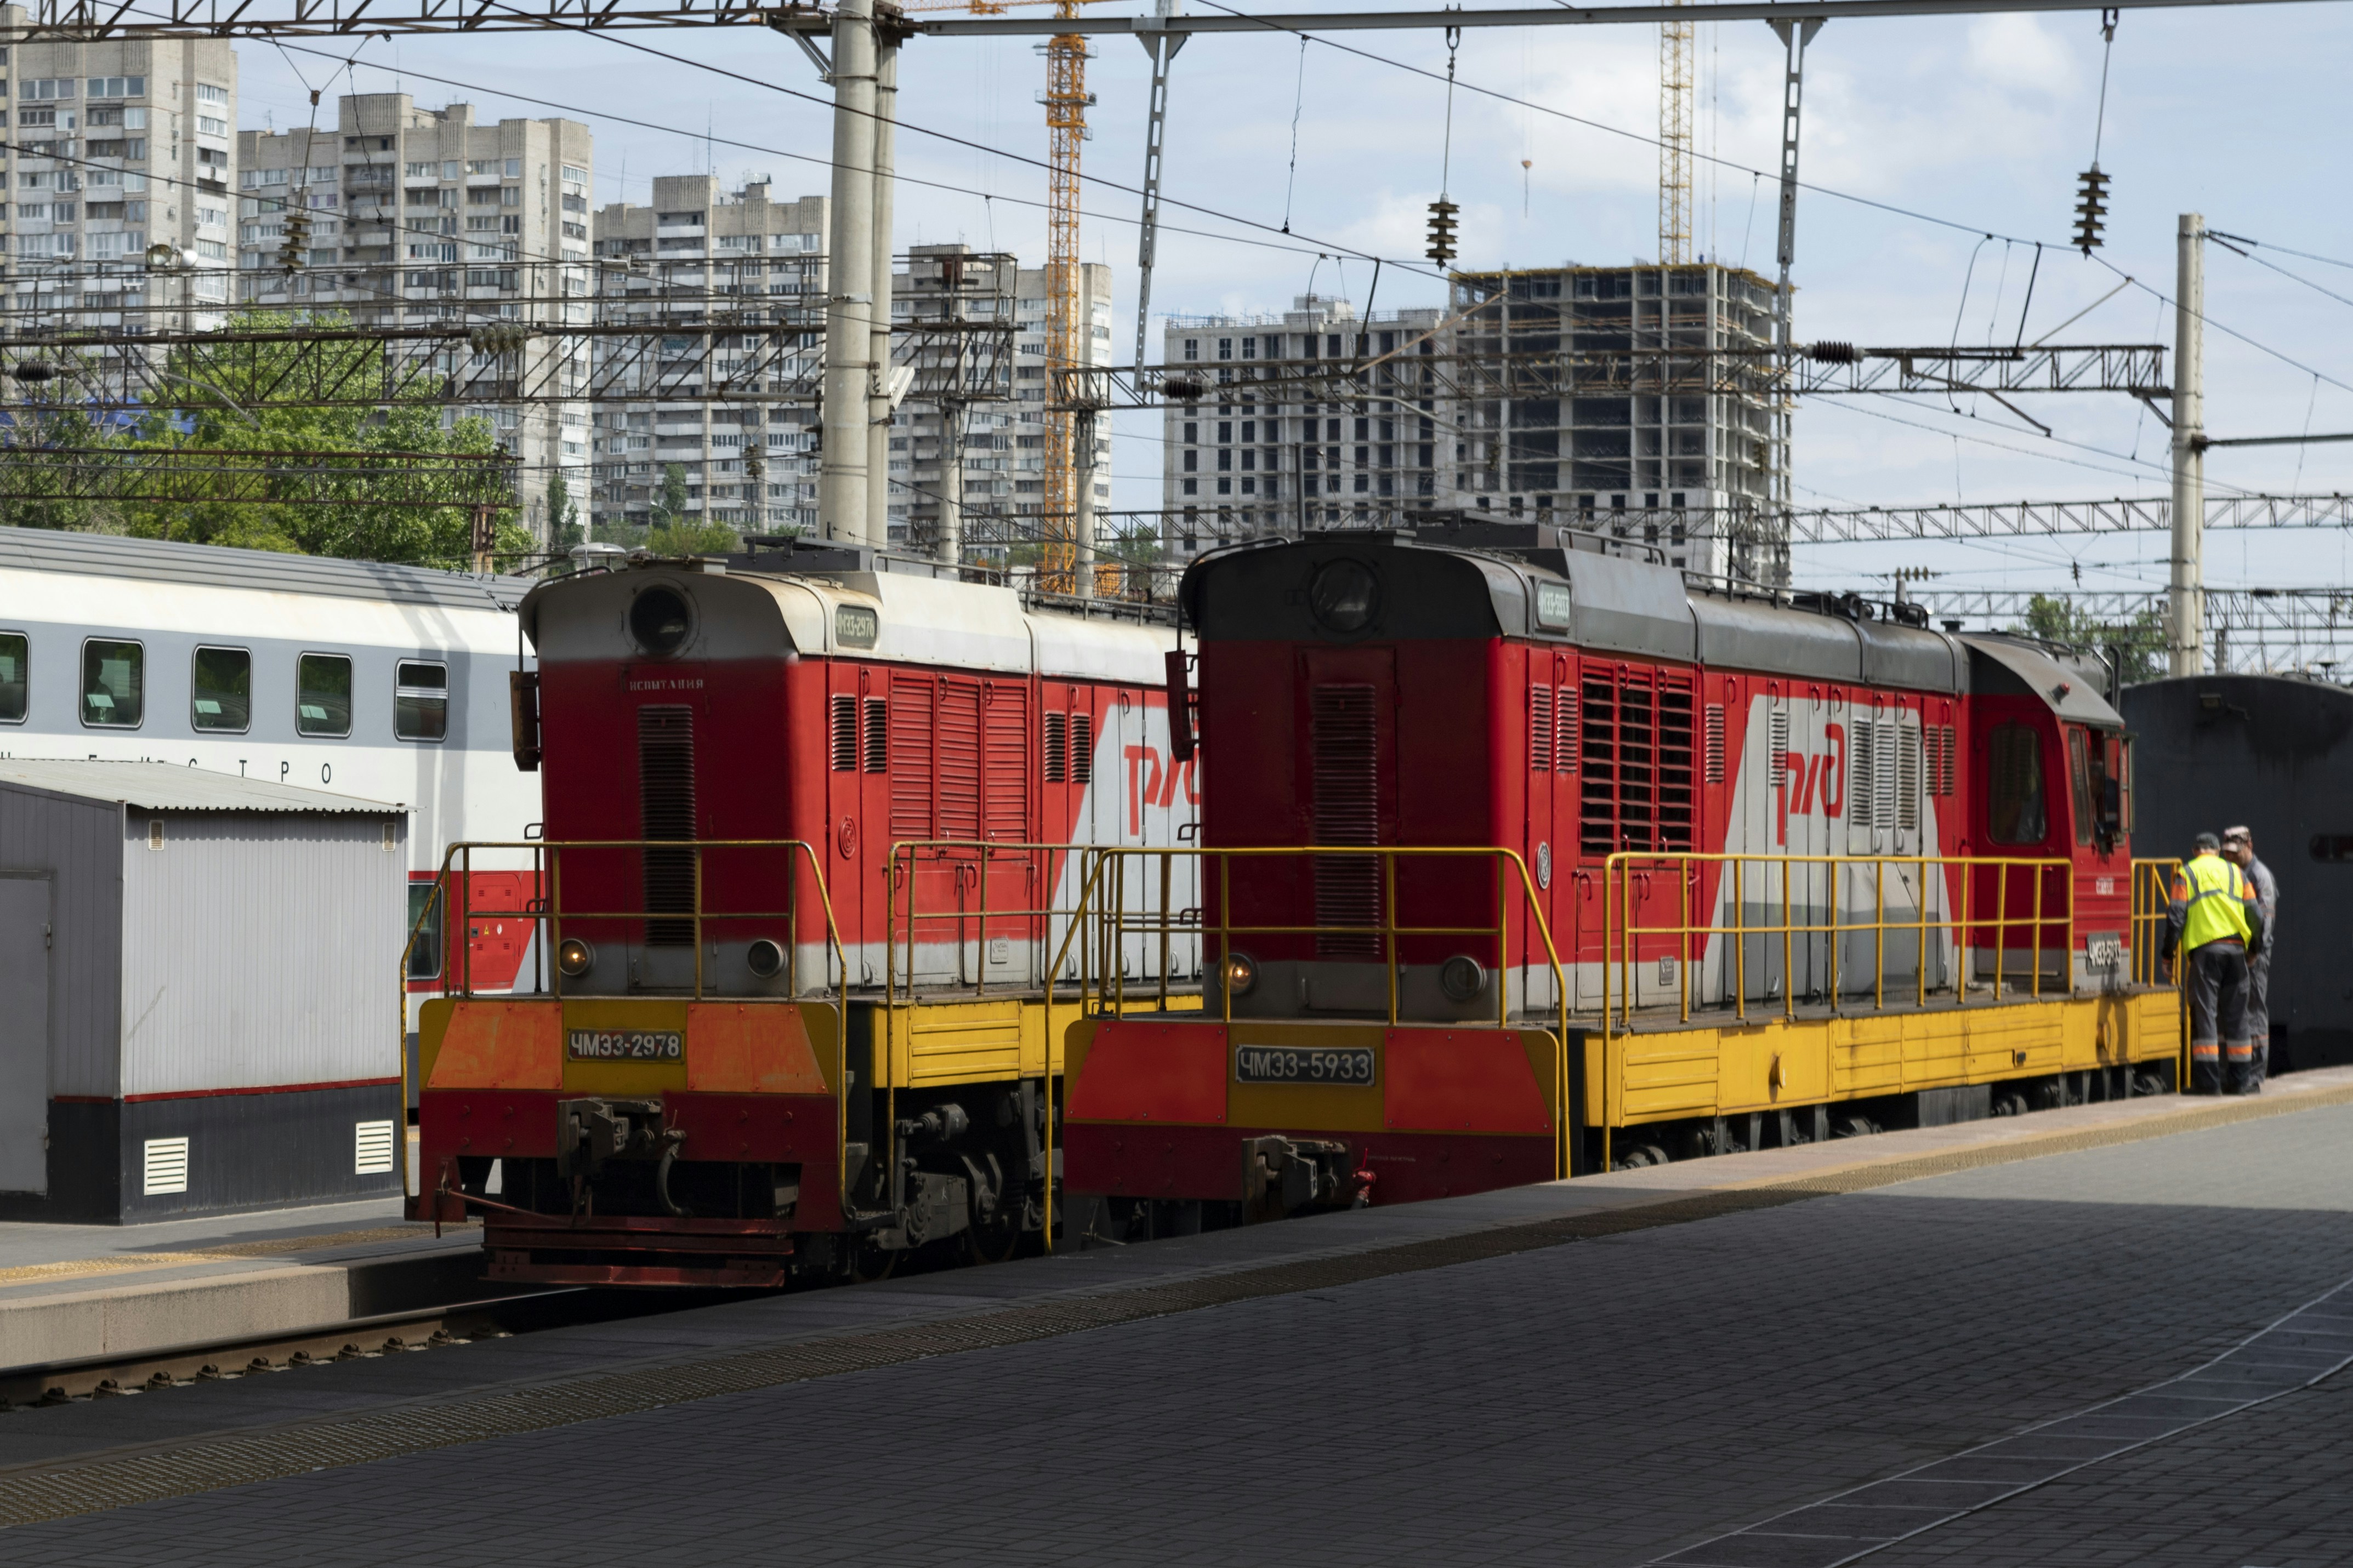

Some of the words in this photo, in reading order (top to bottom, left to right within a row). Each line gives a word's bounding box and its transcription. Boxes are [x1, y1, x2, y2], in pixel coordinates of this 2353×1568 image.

[629, 679, 703, 691] ИСПЫТАНИЯ
[571, 1033, 679, 1057] ЧМЭ3-2978
[1240, 1052, 1369, 1079] ЧМЭ3-5933
